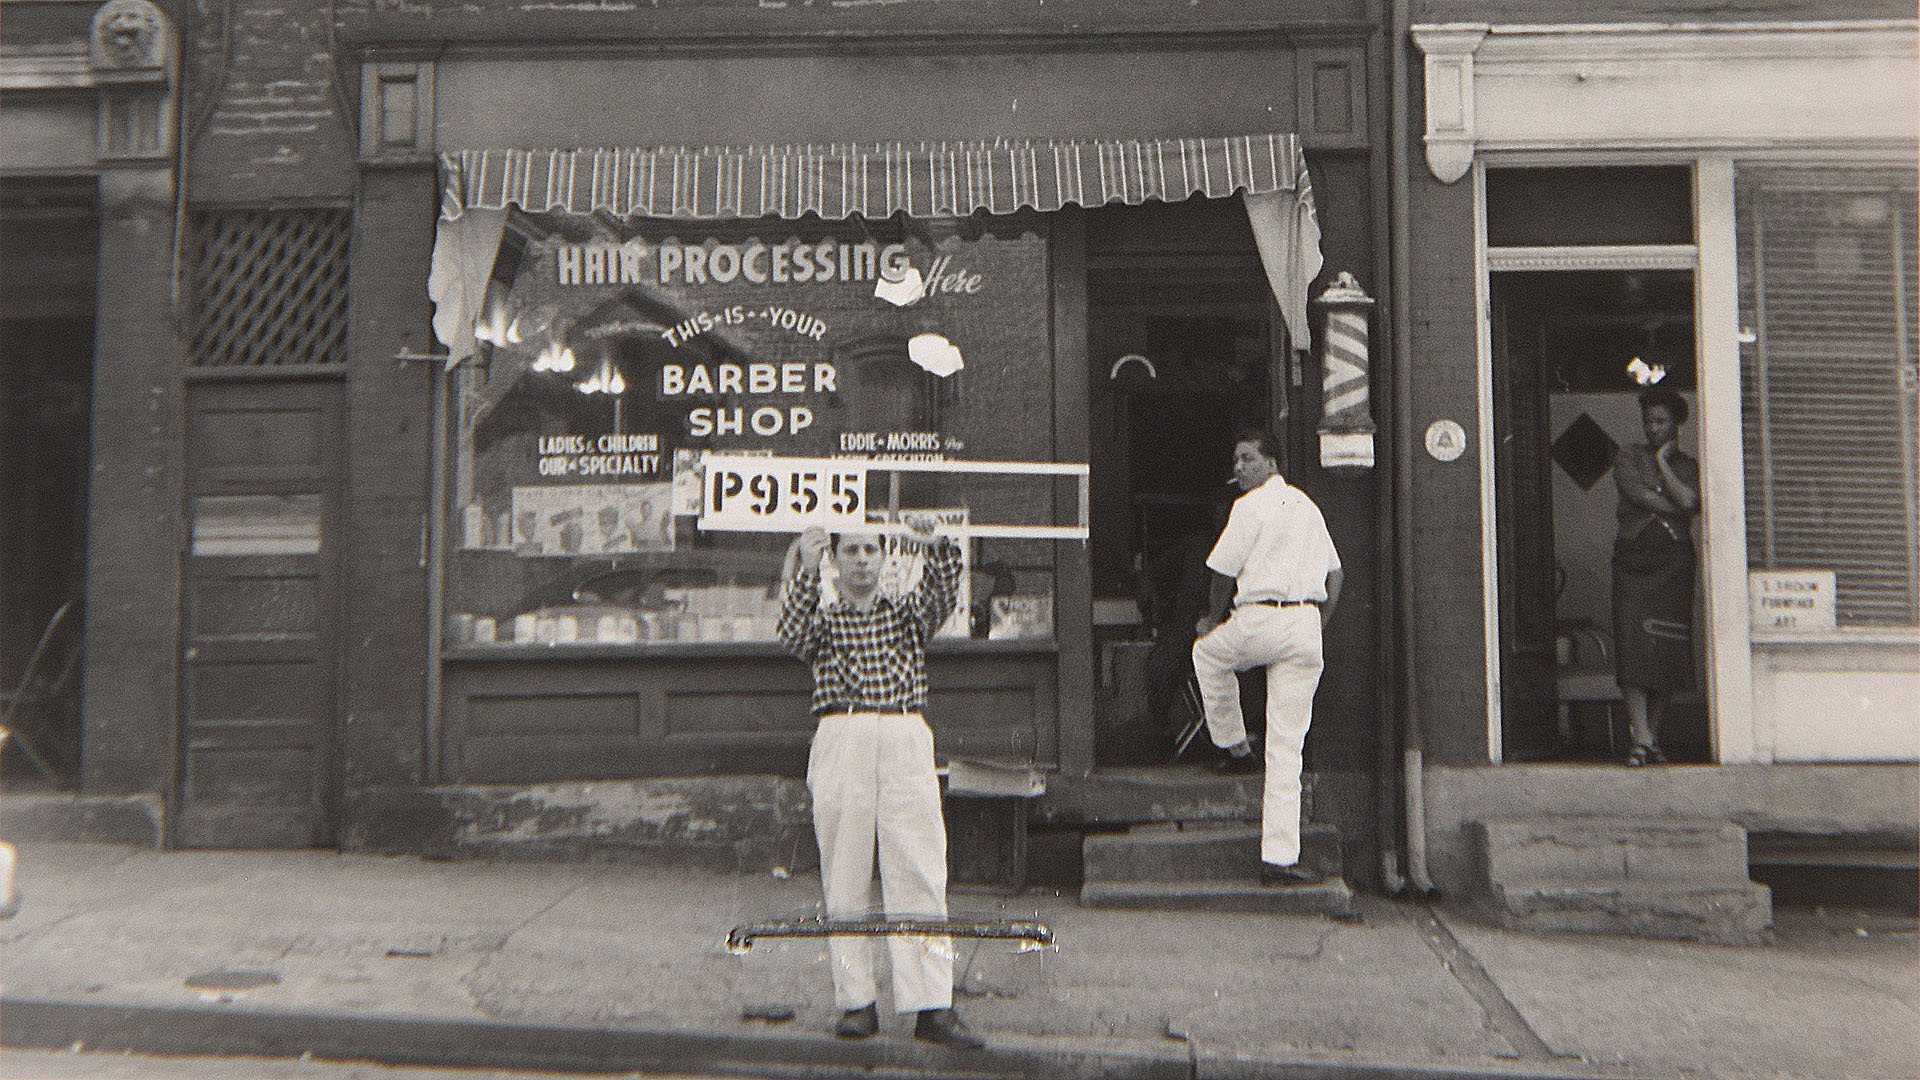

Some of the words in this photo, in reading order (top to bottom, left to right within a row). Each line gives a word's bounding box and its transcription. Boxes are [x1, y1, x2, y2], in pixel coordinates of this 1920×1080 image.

[558, 246, 641, 285] HAIR
[920, 254, 983, 298] Here
[662, 311, 714, 348] THIS
[725, 305, 745, 325] IS
[768, 306, 828, 341] YOUR
[662, 362, 838, 395] BARBER
[688, 406, 814, 437] SHOP
[538, 436, 586, 455] LADIES
[597, 434, 659, 453] CHILDREN
[839, 432, 877, 451] EDDIE
[886, 432, 940, 451] MORRIS
[539, 456, 568, 476] OUR
[579, 453, 660, 476] SPECIALTY
[713, 471, 860, 515] P955
